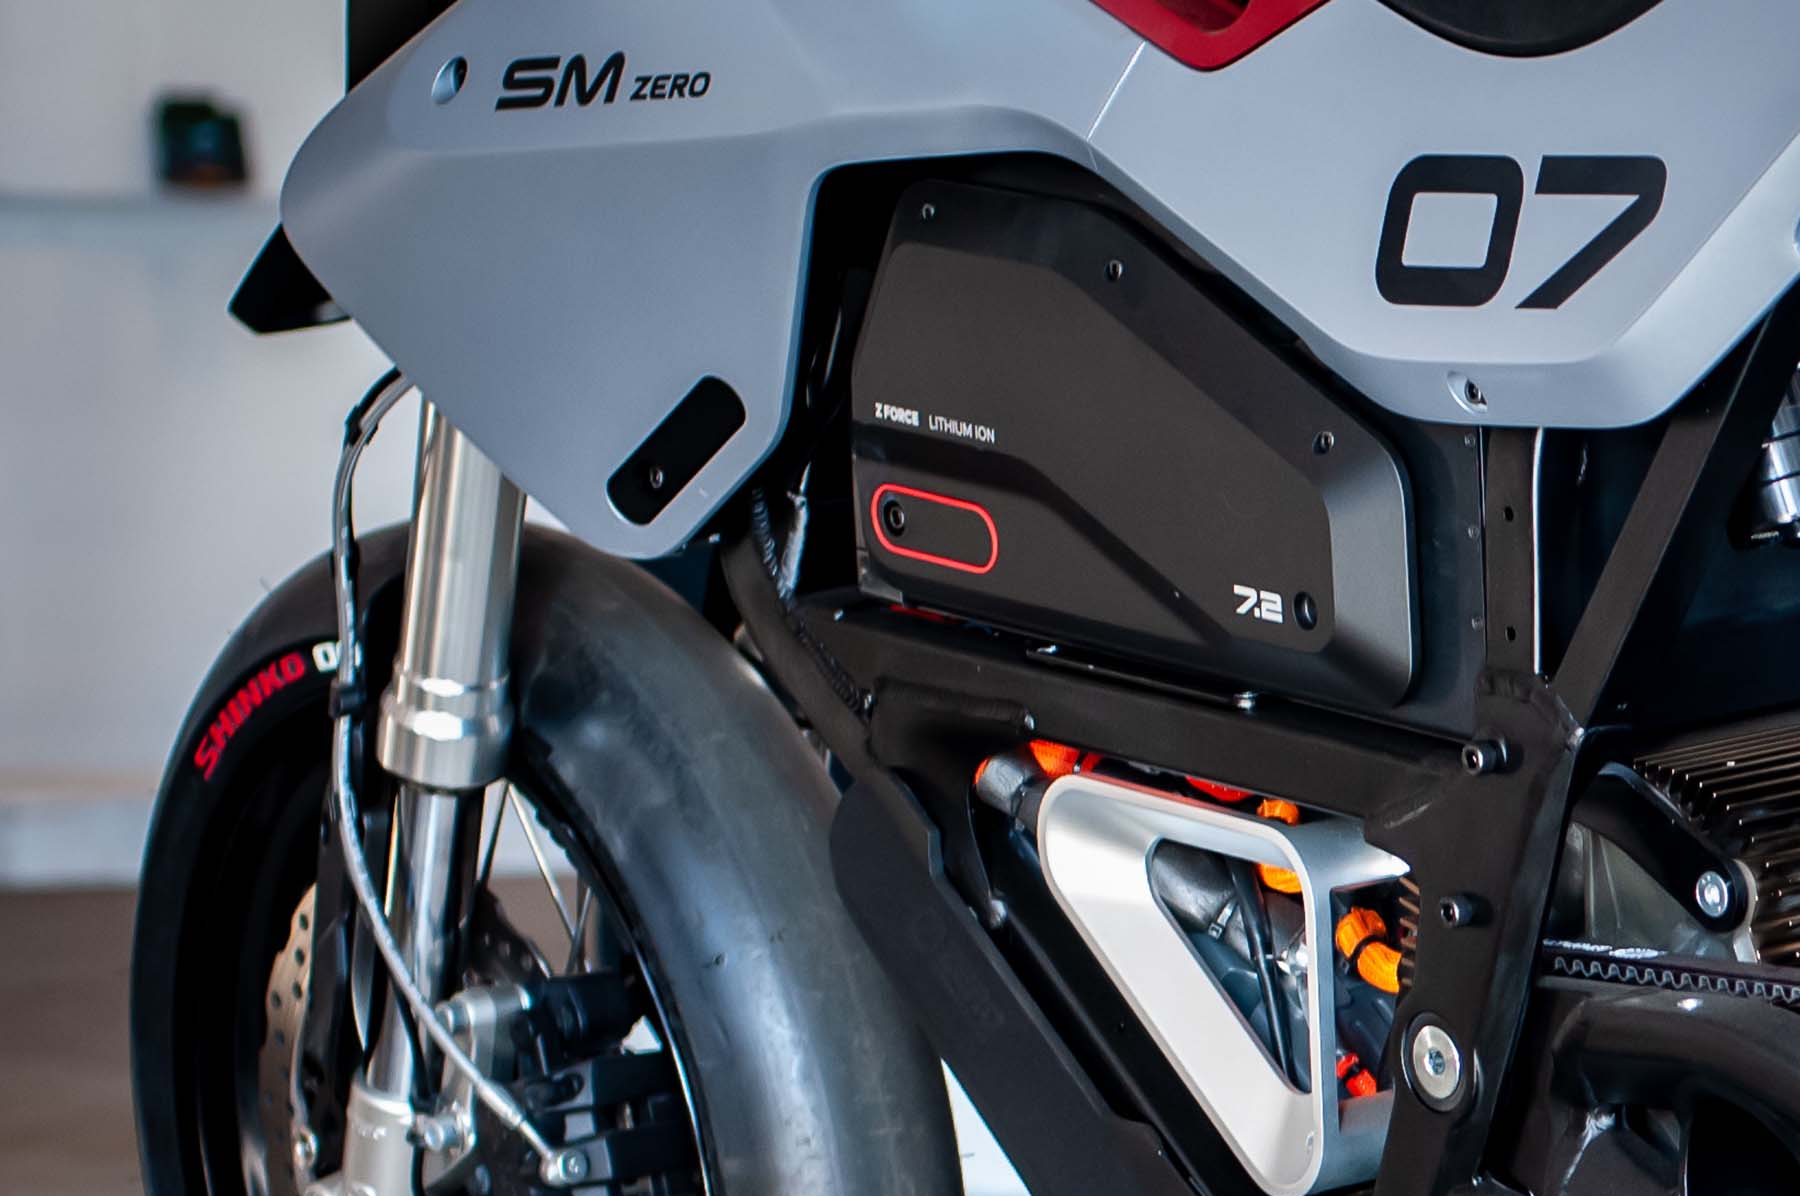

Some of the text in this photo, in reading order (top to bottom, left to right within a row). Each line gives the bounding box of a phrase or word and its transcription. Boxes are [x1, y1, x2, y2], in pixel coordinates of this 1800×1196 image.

[495, 50, 712, 112] SM ZERO
[1375, 154, 1668, 310] 07
[883, 404, 920, 427] FORCE
[928, 414, 973, 439] LITHIUM
[974, 425, 996, 444] ION
[1233, 584, 1284, 624] 7.2
[194, 651, 306, 782] SHINKO
